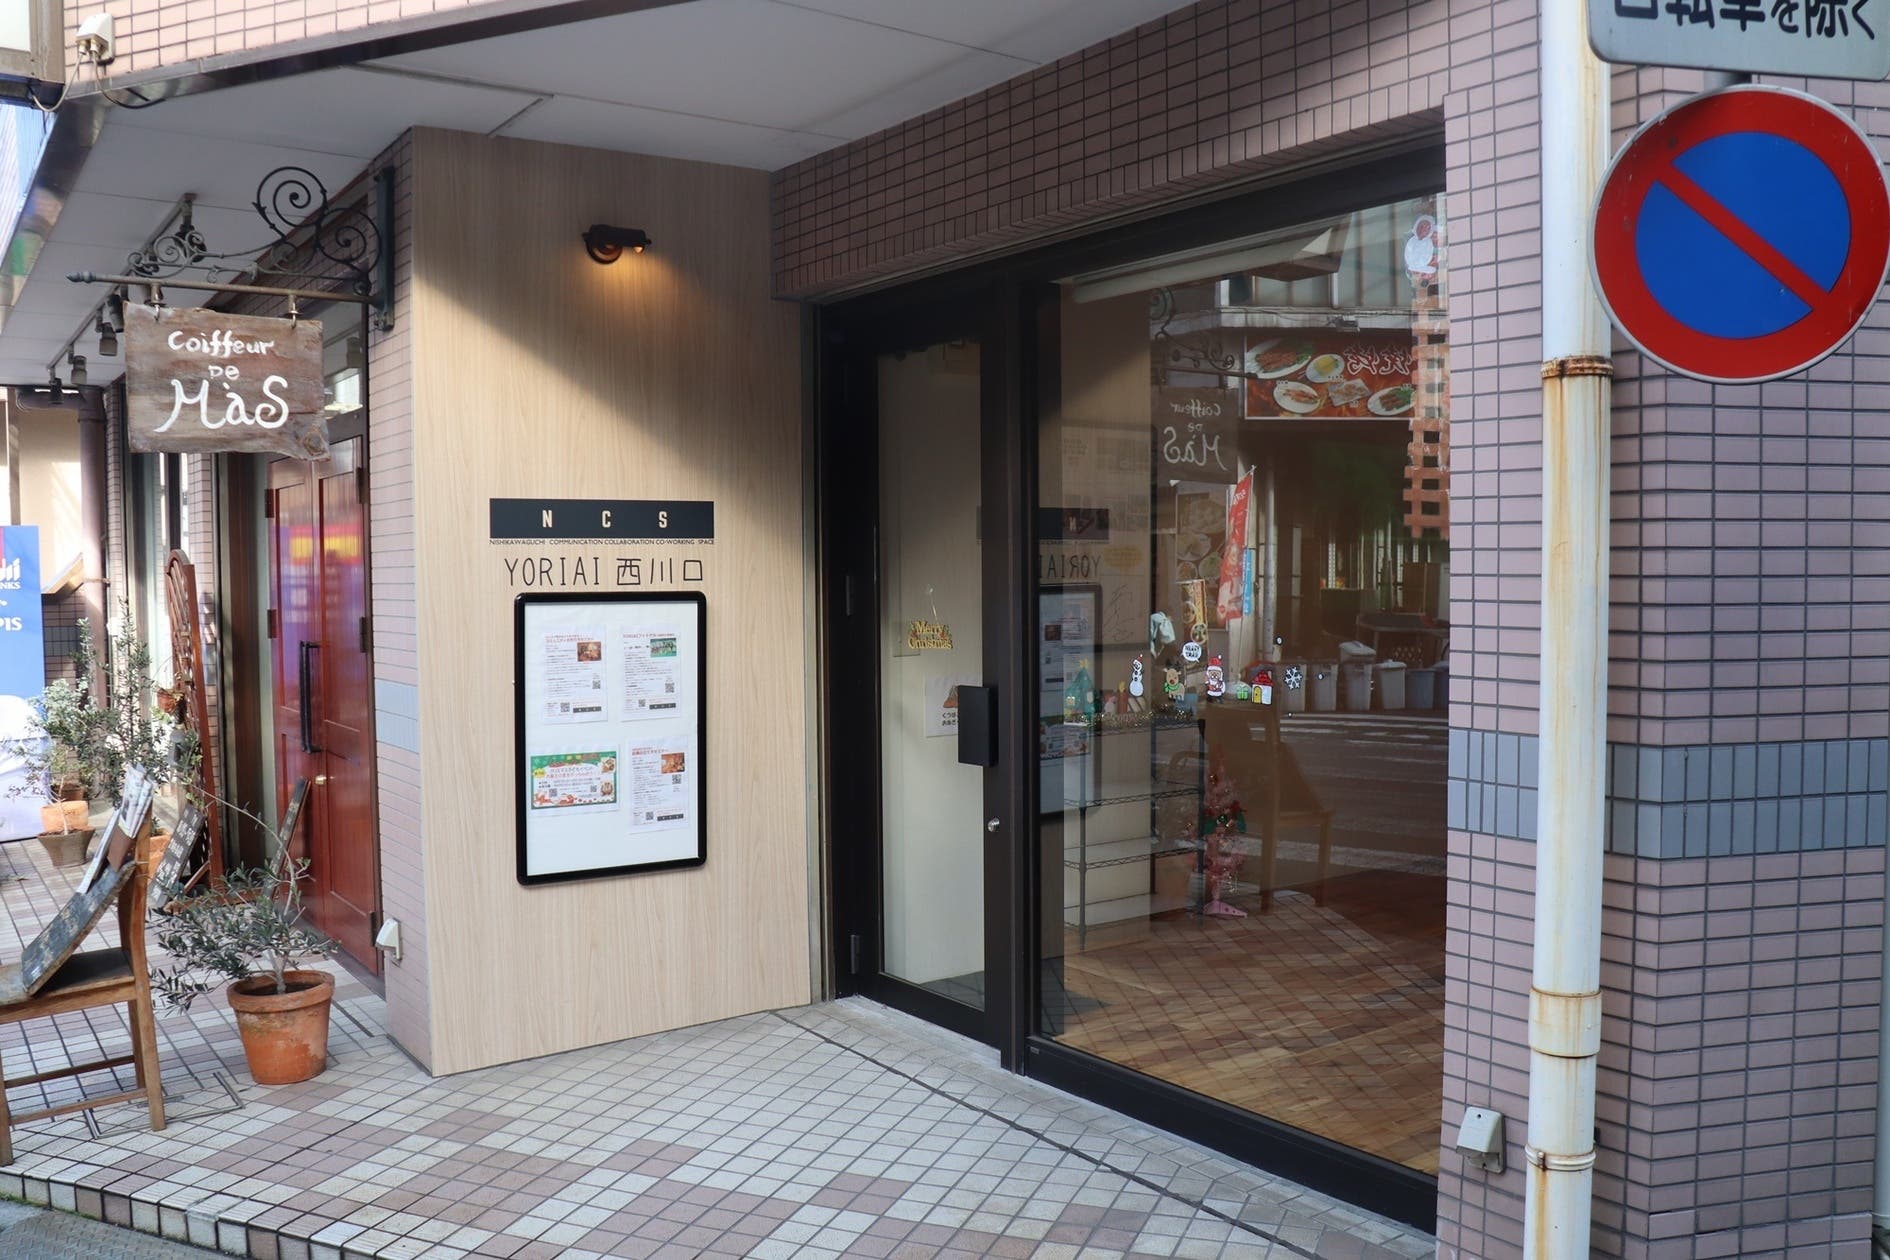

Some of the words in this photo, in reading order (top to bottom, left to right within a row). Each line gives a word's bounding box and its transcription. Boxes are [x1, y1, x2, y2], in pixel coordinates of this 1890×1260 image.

[167, 329, 275, 357] Coiffeur
[504, 556, 600, 587] YORIAI
[616, 557, 703, 586] 西川口
[914, 620, 945, 635] Merry
